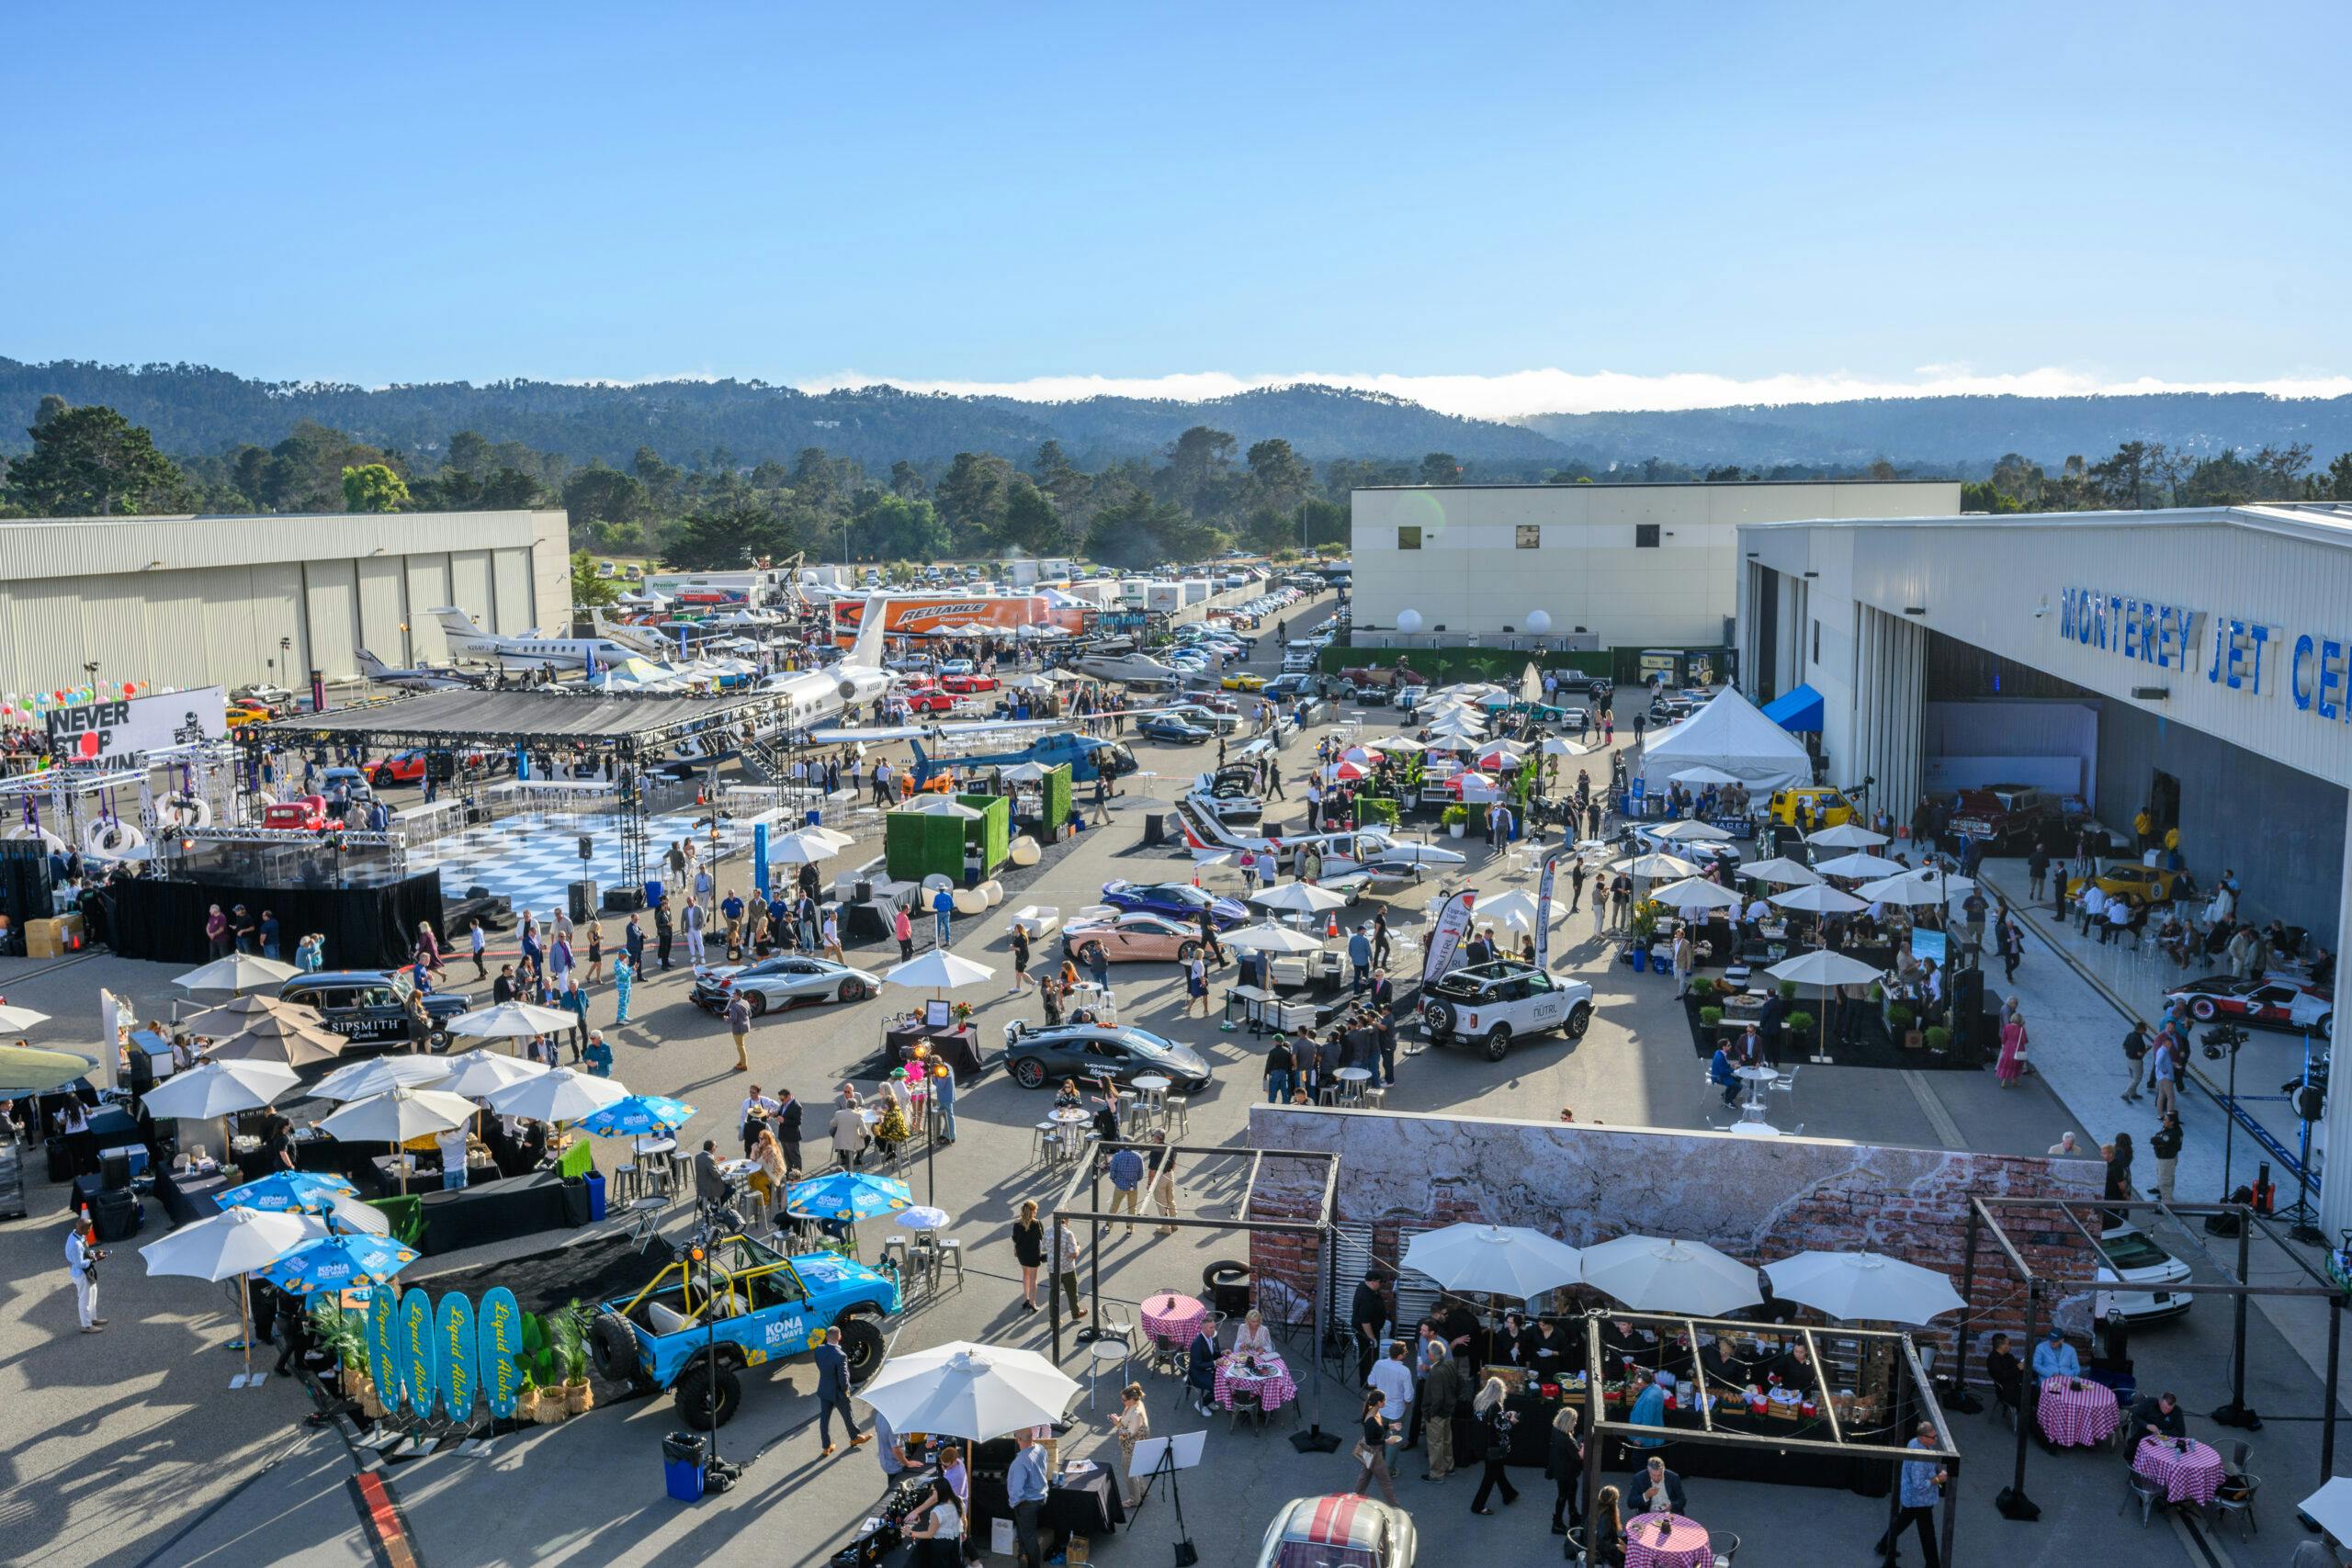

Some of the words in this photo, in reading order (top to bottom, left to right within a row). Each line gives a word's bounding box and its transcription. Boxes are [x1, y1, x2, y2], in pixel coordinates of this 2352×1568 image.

[896, 603, 988, 626] RELIABLE
[2061, 586, 2197, 673] MONTEREY
[2208, 616, 2270, 696] JET
[2291, 634, 2352, 725] CE
[52, 701, 130, 734] NEVER
[332, 1019, 399, 1032] SIPSMITH
[352, 1031, 379, 1040] London
[317, 1263, 349, 1273] KONA
[376, 1297, 391, 1351] Liquid
[407, 1302, 424, 1357] Liquid
[446, 1305, 465, 1360] Liquid
[491, 1301, 510, 1354] Liquid
[765, 1314, 804, 1337] KONA
[765, 1335, 780, 1345] BIG
[781, 1326, 804, 1340] WAVE
[381, 1353, 395, 1395] Aloha
[414, 1359, 429, 1403] Aloha
[451, 1363, 467, 1406] Aloha
[497, 1358, 512, 1402] Aloha
